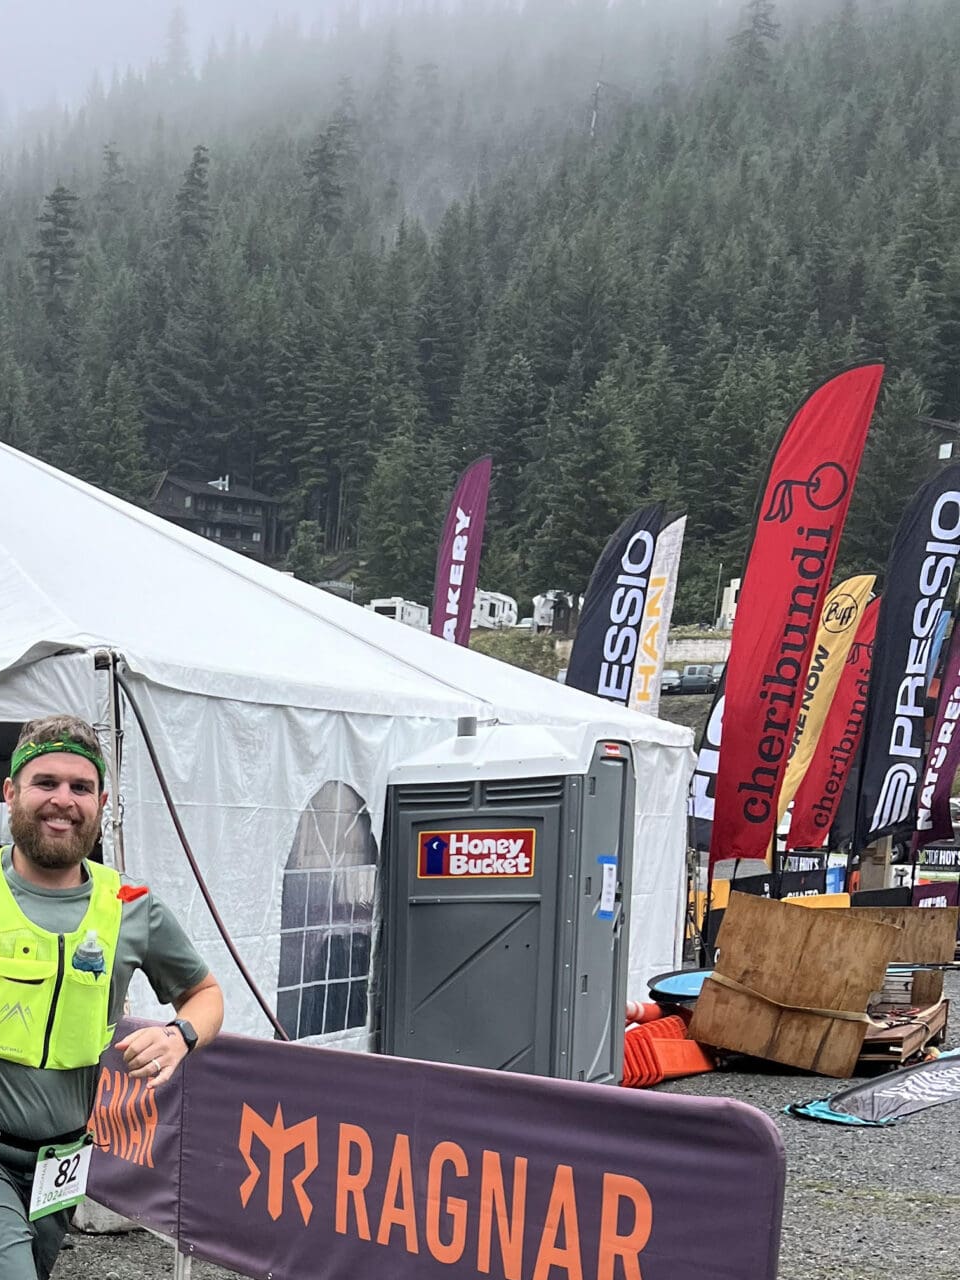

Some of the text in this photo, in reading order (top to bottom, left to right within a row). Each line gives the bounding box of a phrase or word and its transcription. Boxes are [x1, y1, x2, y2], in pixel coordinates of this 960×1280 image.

[597, 529, 654, 701] ESSIO
[636, 576, 667, 702] HAN
[737, 524, 833, 824] cheribundi
[801, 643, 830, 711] NOW
[449, 834, 524, 858] Honey
[449, 853, 530, 875] Bucket
[54, 1153, 81, 1188] 82
